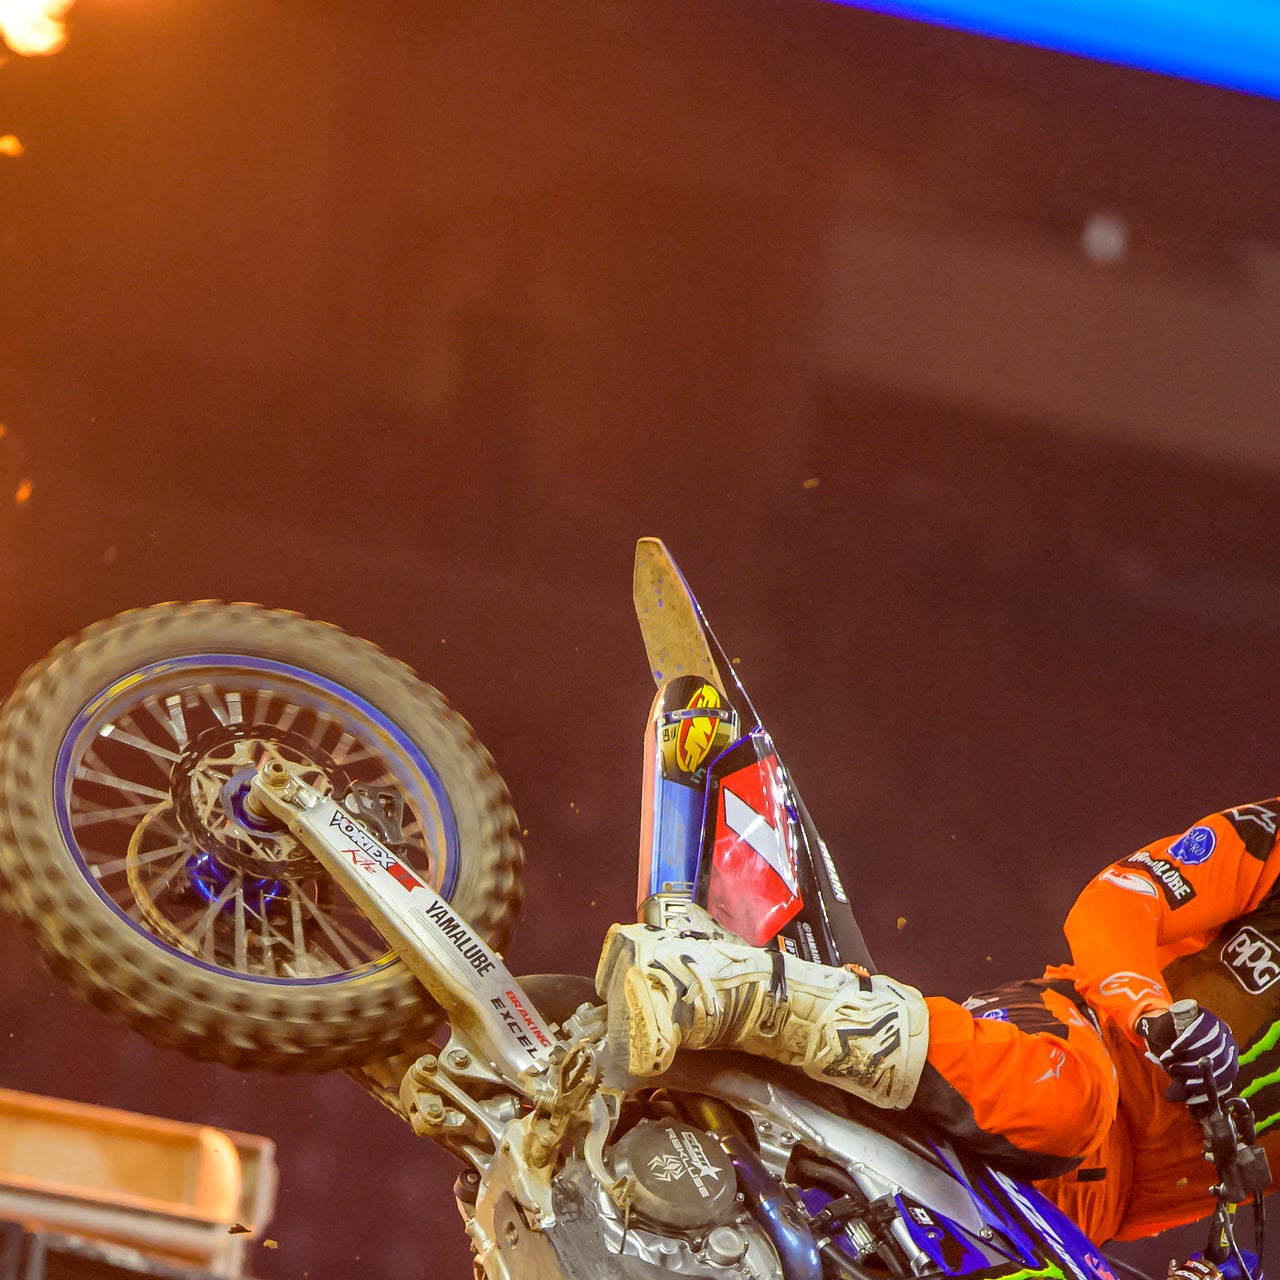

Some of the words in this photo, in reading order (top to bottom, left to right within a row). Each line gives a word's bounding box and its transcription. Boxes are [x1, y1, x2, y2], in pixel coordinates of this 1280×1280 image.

[329, 809, 398, 871] VORTEX
[424, 899, 496, 978] YAMALUBE
[1227, 932, 1280, 987] PPG
[490, 996, 538, 1059] EXCEL
[505, 989, 552, 1048] BRAKING
[665, 1127, 710, 1198] REKLUSE
